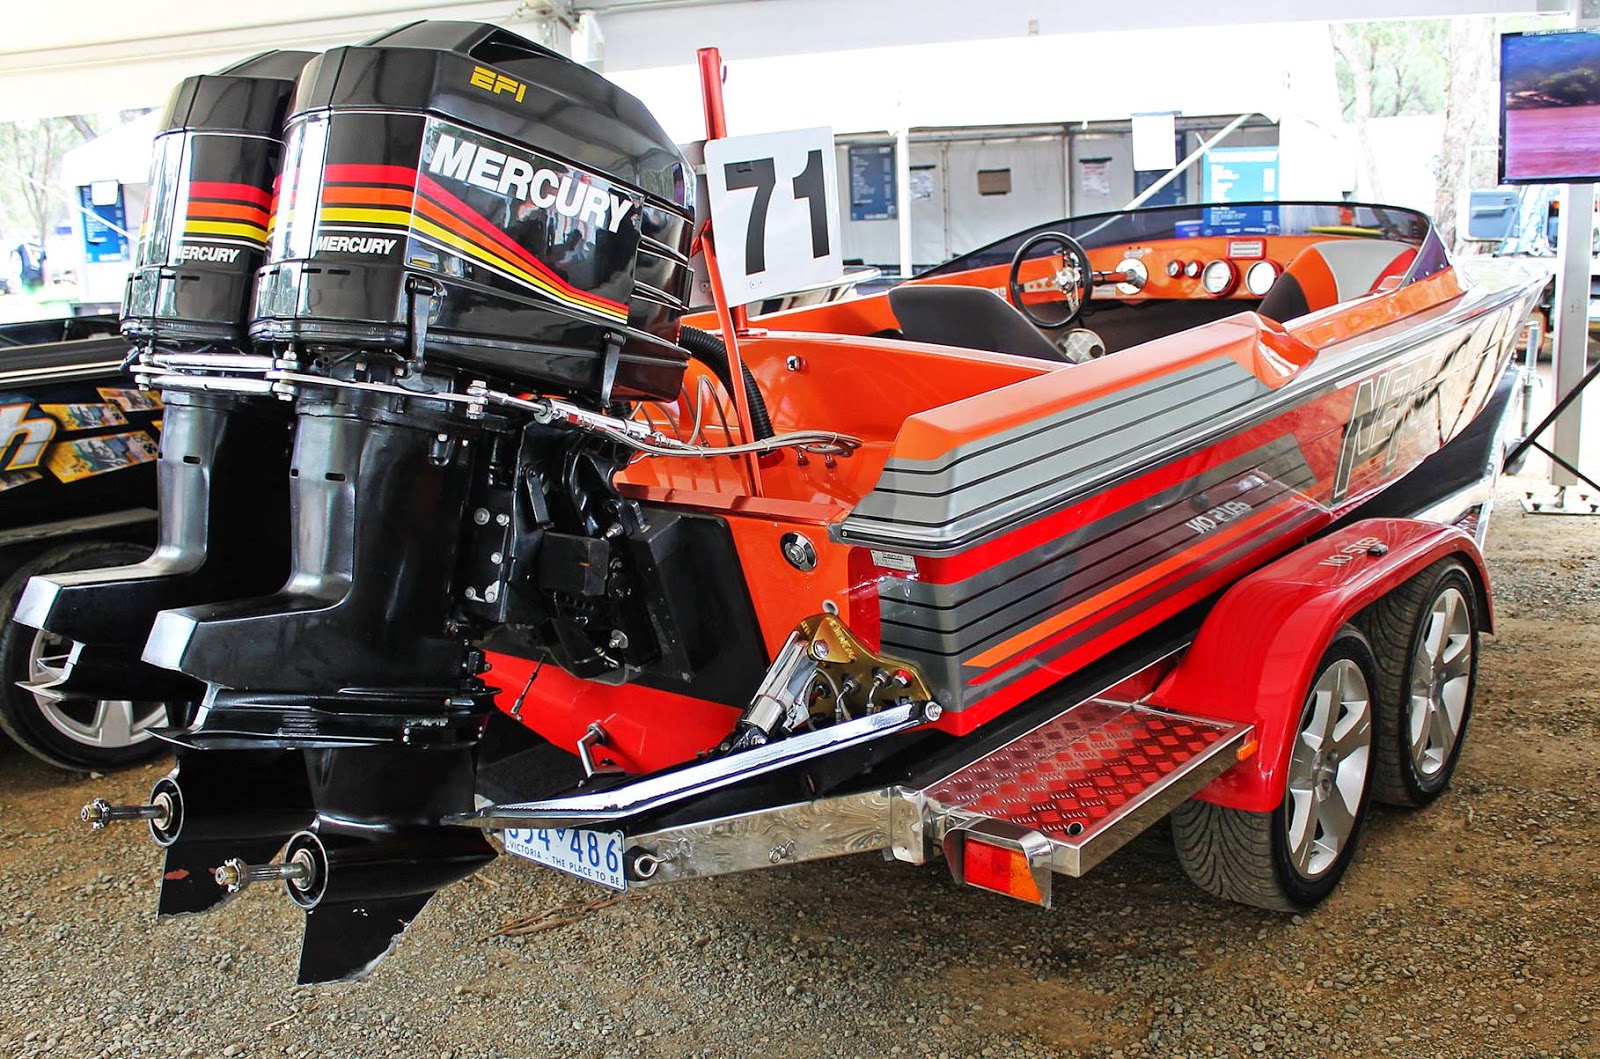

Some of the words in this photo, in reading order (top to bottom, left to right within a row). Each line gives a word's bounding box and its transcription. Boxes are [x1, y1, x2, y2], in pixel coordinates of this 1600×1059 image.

[470, 65, 527, 103] EFI
[428, 133, 633, 233] MERCURY
[723, 149, 830, 276] 71
[315, 236, 397, 255] MERCURY
[509, 840, 542, 859] VICTORIA
[552, 855, 566, 868] THE
[569, 862, 592, 877] PLACE
[595, 870, 606, 881] TO
[569, 829, 618, 873] 486
